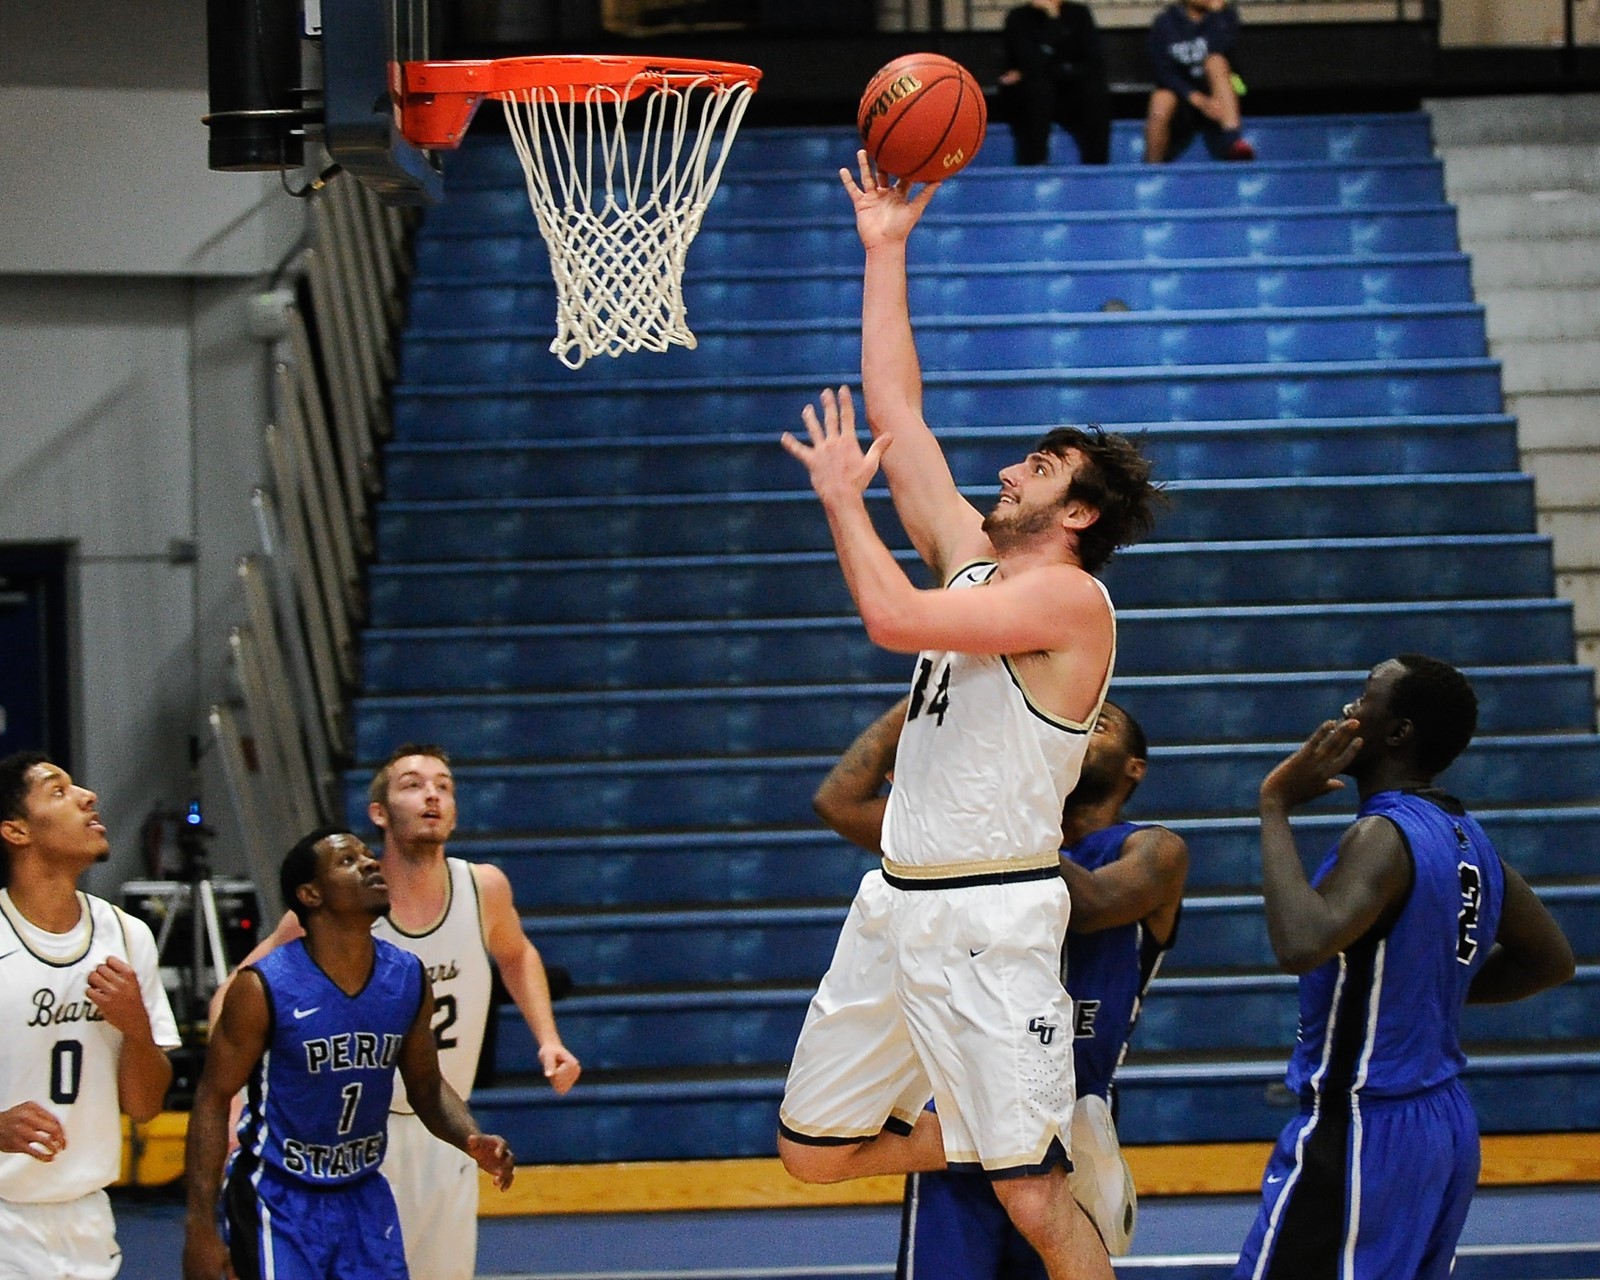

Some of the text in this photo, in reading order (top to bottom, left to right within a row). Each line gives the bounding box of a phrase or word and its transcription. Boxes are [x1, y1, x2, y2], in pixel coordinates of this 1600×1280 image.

[434, 994, 457, 1050] 2
[50, 1039, 83, 1105] 0
[337, 1082, 363, 1135] 1
[283, 1131, 384, 1178] STATE
